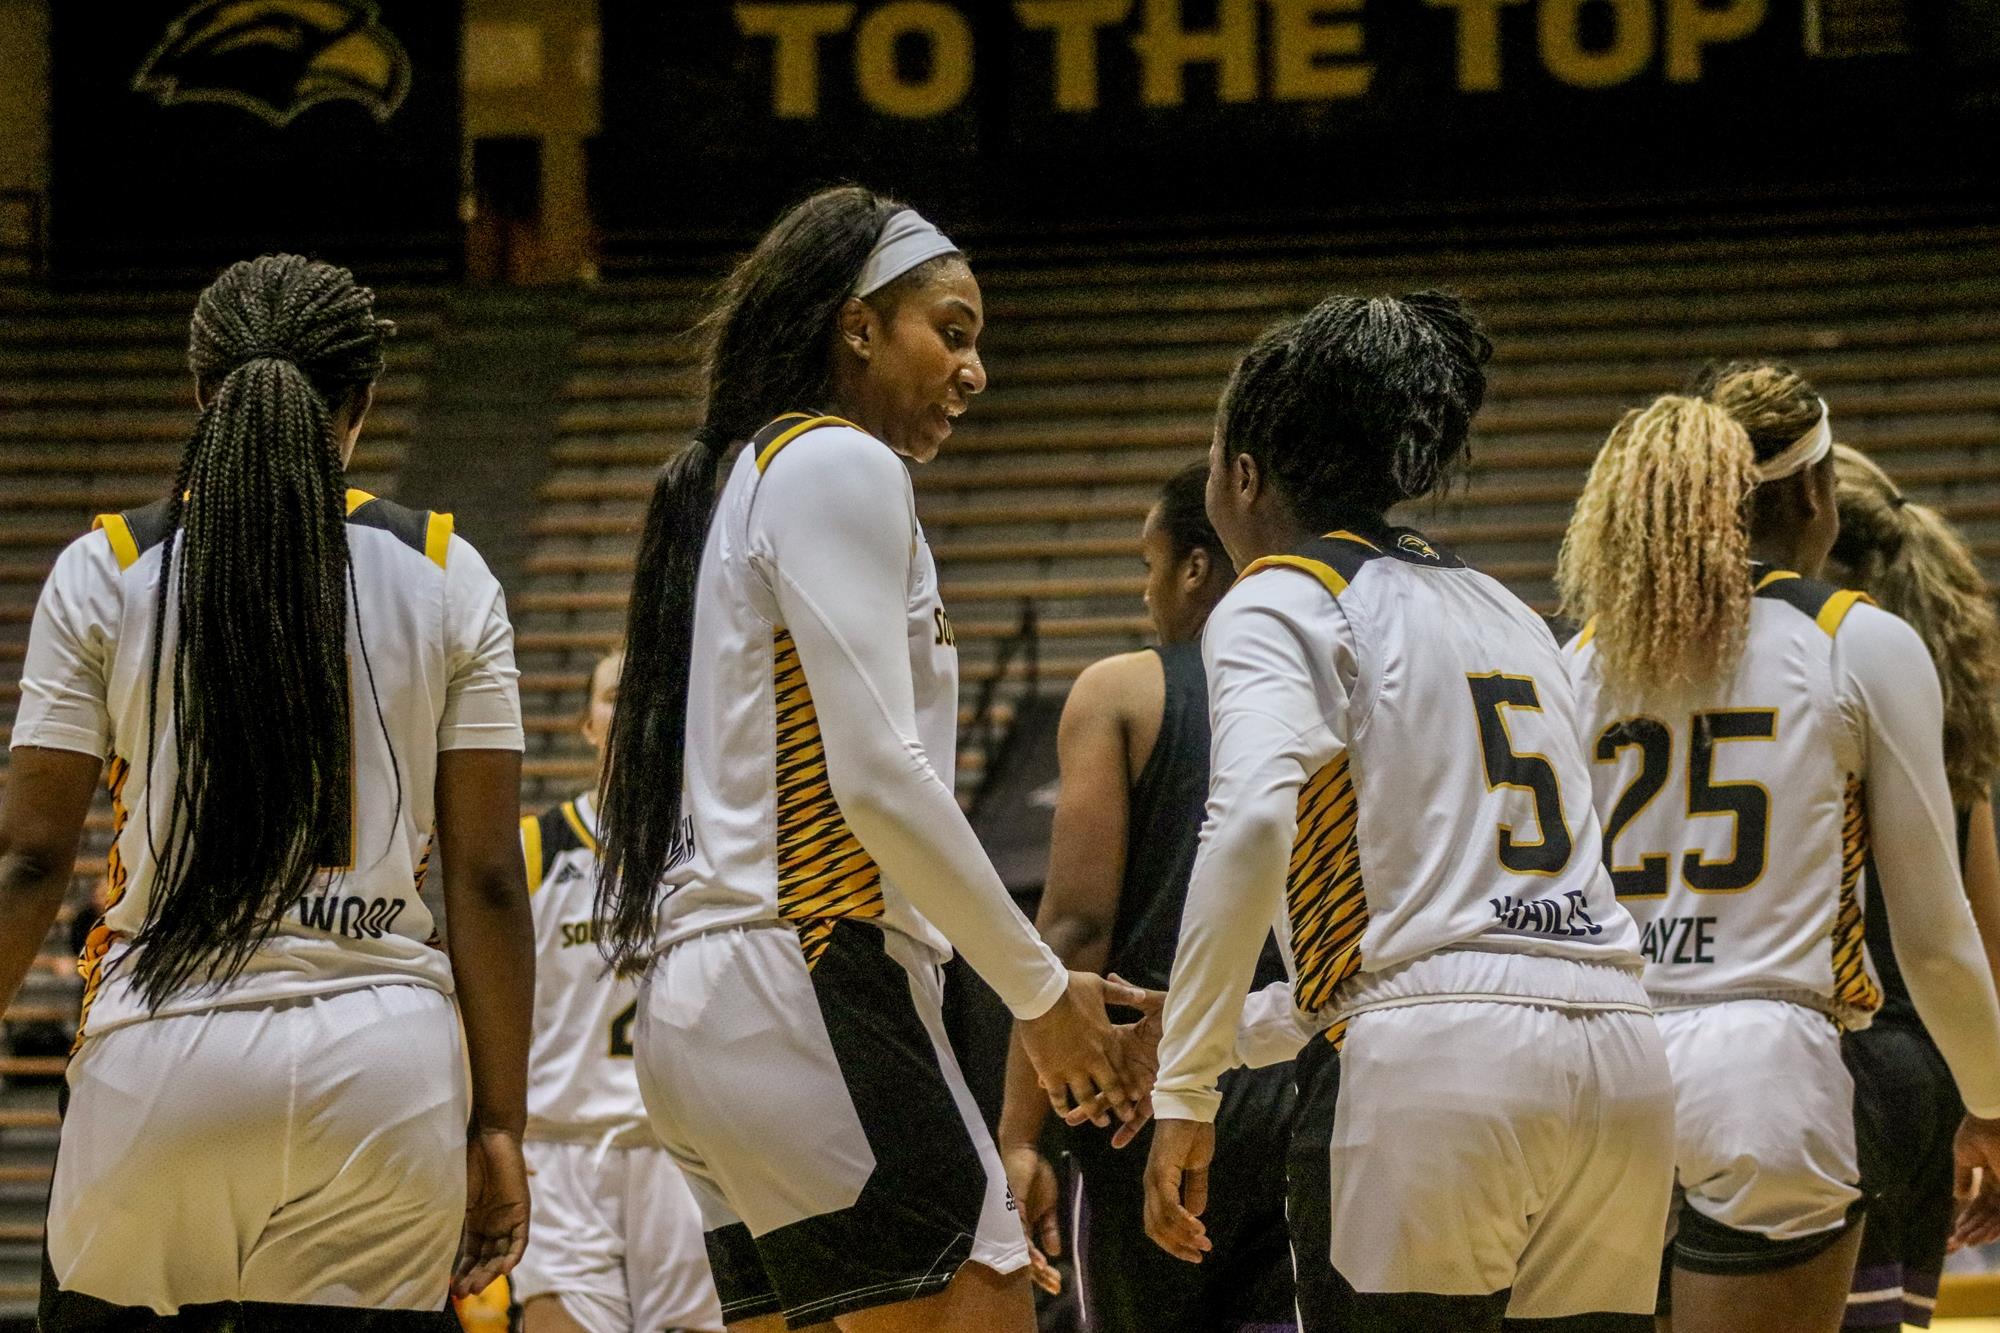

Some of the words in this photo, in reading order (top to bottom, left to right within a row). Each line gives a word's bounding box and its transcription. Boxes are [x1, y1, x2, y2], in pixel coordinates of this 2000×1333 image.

[732, 2, 976, 119] TO
[1013, 0, 1374, 112] THE
[1424, 0, 1766, 90] TOP
[1466, 669, 1575, 877] 5
[1594, 707, 1780, 900] 25
[1640, 916, 1717, 964] AYZE
